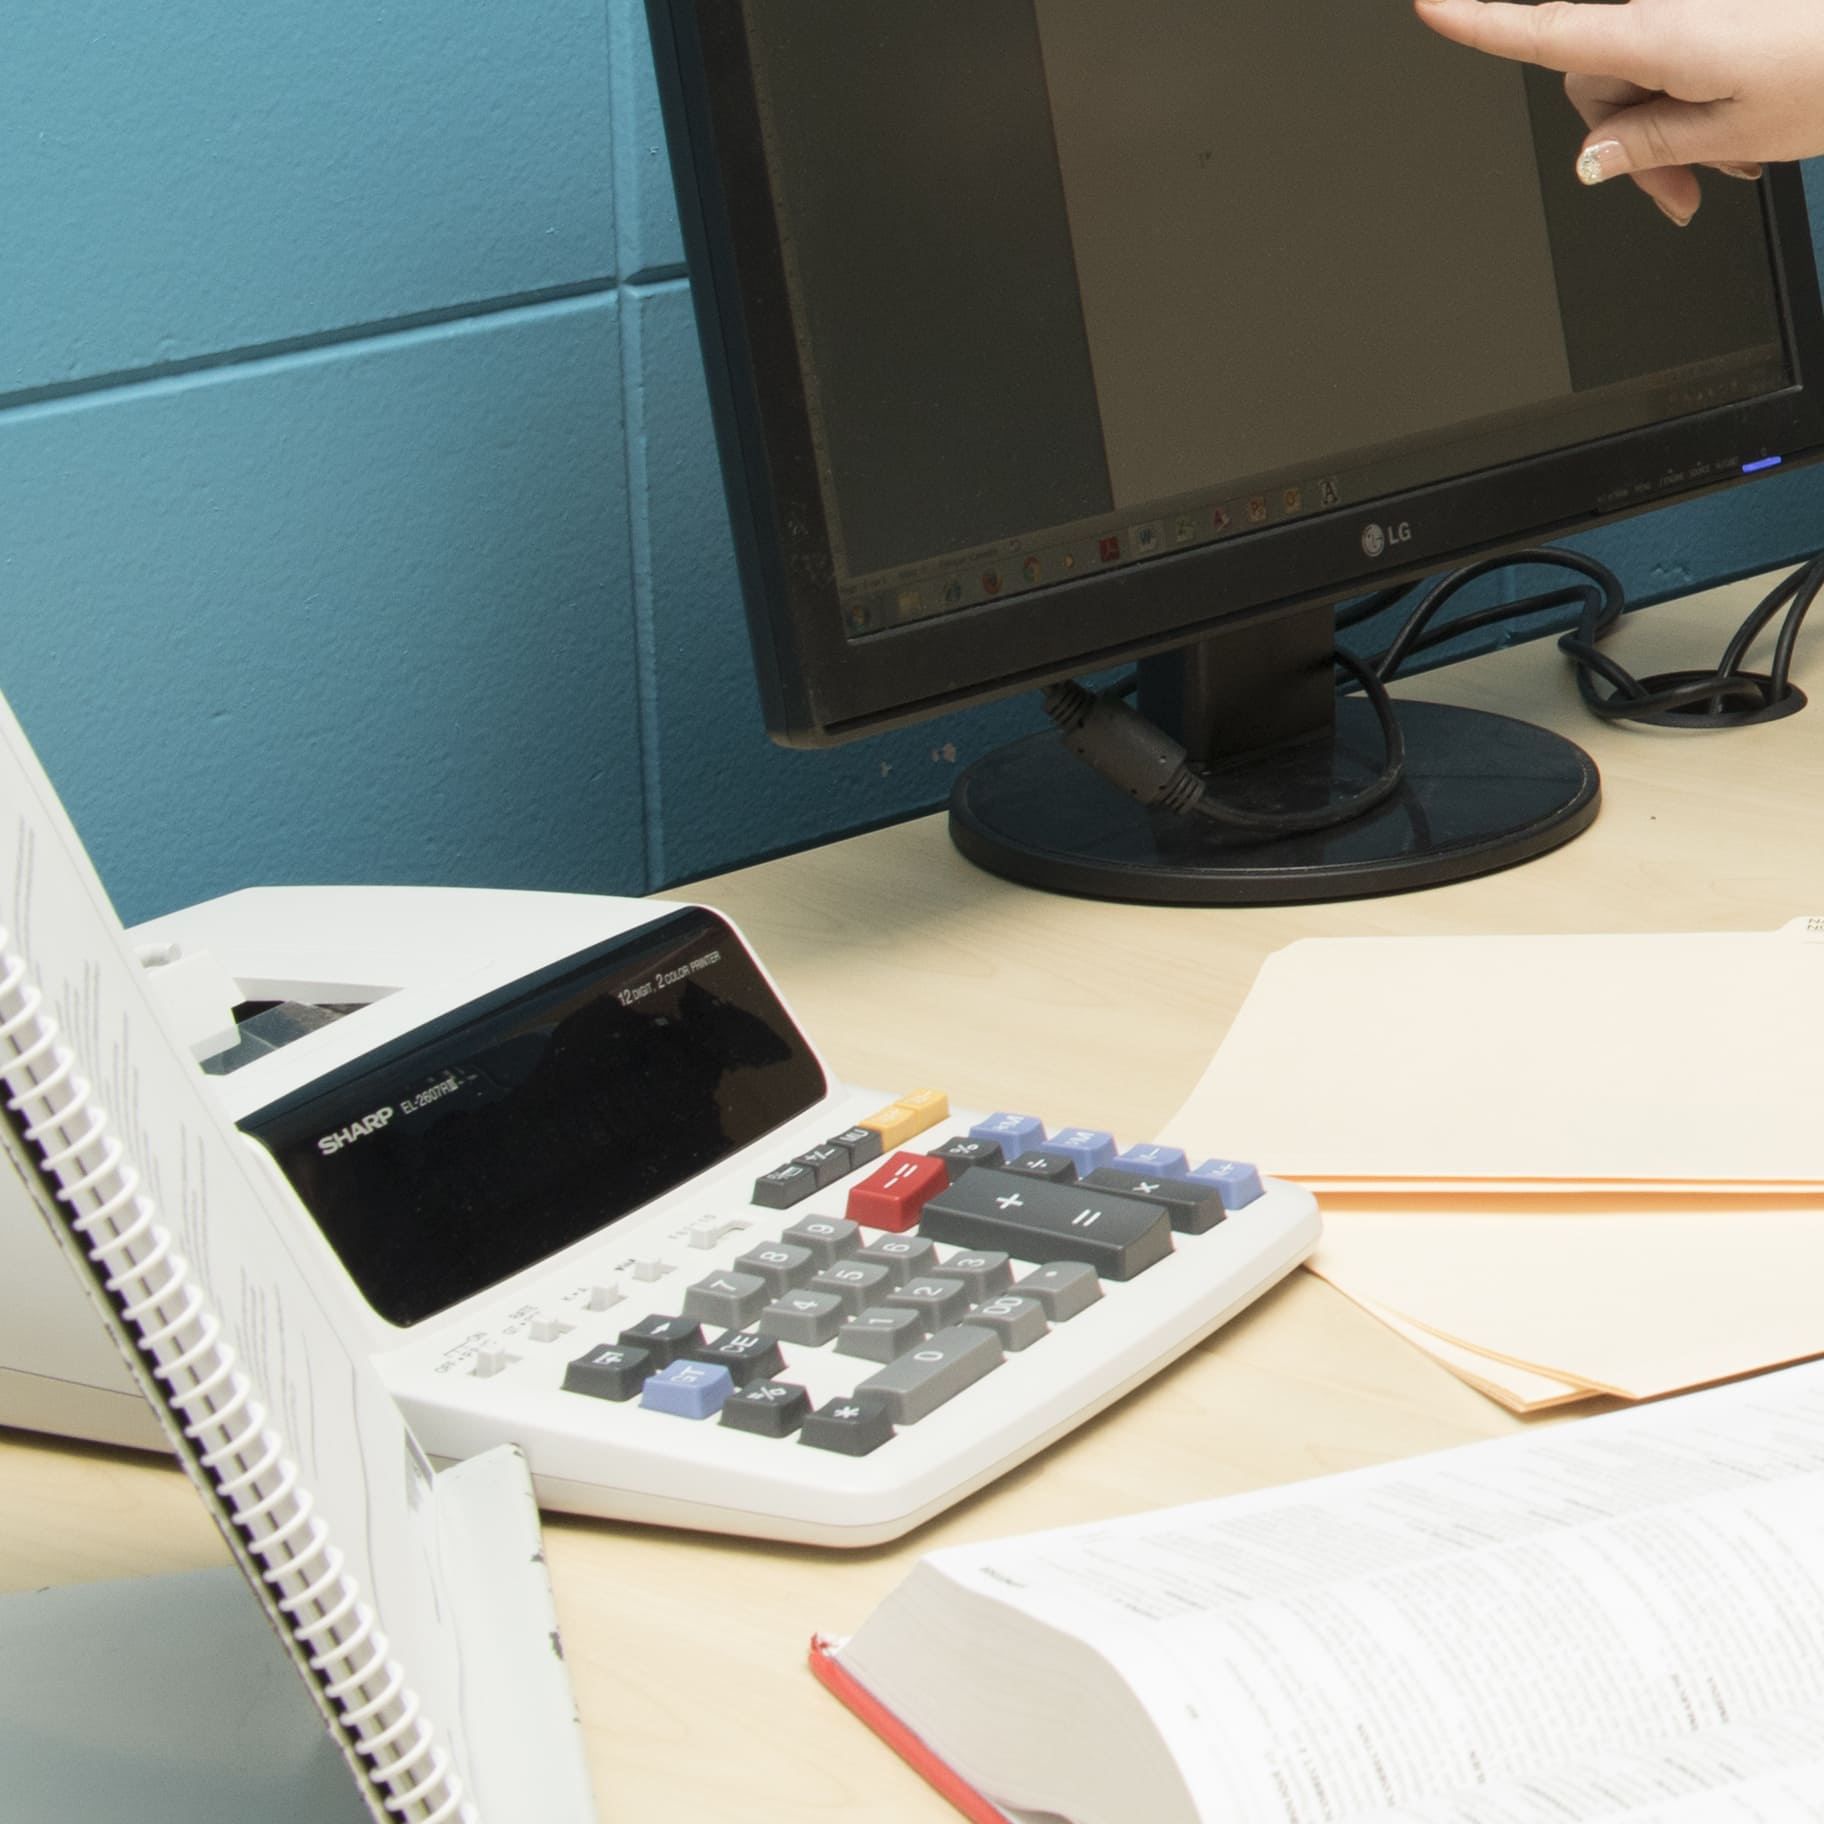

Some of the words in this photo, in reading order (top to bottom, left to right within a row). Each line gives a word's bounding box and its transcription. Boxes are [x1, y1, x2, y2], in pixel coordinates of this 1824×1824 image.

[1388, 522, 1412, 546] LG
[617, 988, 633, 1007] 12
[655, 972, 666, 989] 2
[664, 964, 690, 985] COLOR
[689, 950, 721, 973] PRINTER
[317, 1105, 394, 1156] SHARP
[808, 1223, 836, 1236] 9
[882, 1241, 911, 1253] 6
[759, 1250, 789, 1263] 8
[957, 1257, 986, 1268] 3
[839, 1268, 866, 1281] 5
[710, 1278, 738, 1293] 7
[912, 1285, 943, 1297] 2
[792, 1299, 819, 1311] 4
[914, 1349, 944, 1362] 0
